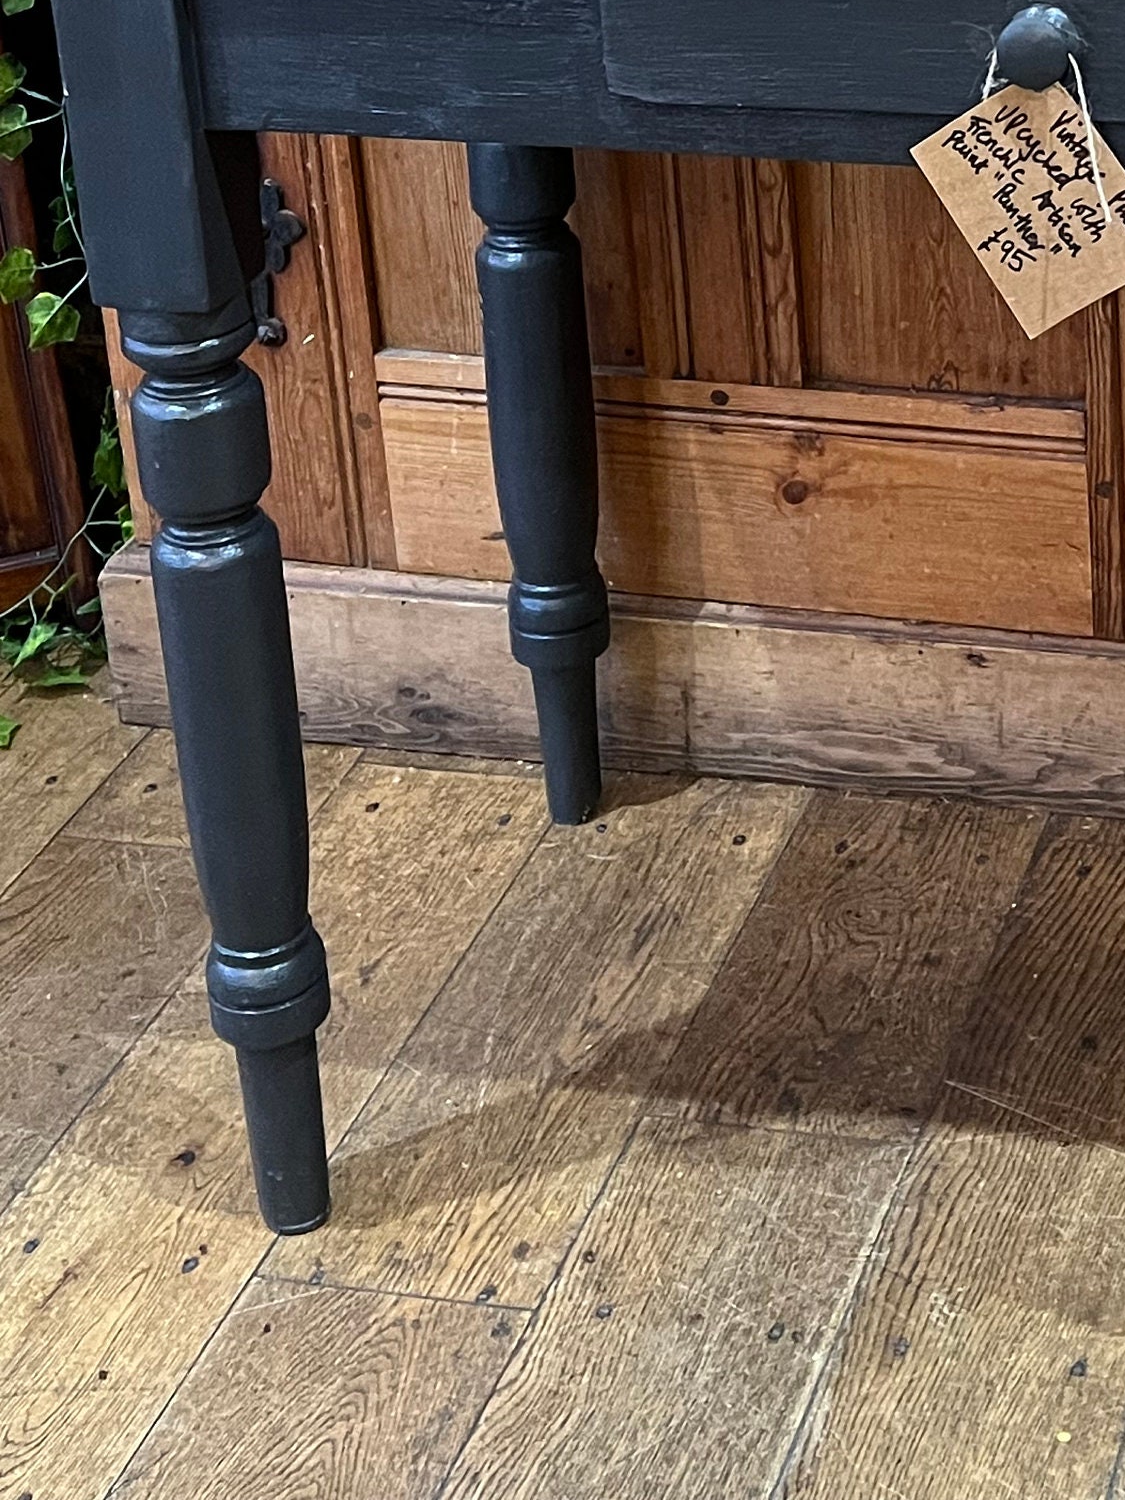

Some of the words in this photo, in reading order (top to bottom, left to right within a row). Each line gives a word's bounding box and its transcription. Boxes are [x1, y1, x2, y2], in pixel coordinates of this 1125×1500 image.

[1032, 190, 1081, 257] Artisan
[1071, 197, 1108, 243] with
[977, 228, 1037, 271] £95
